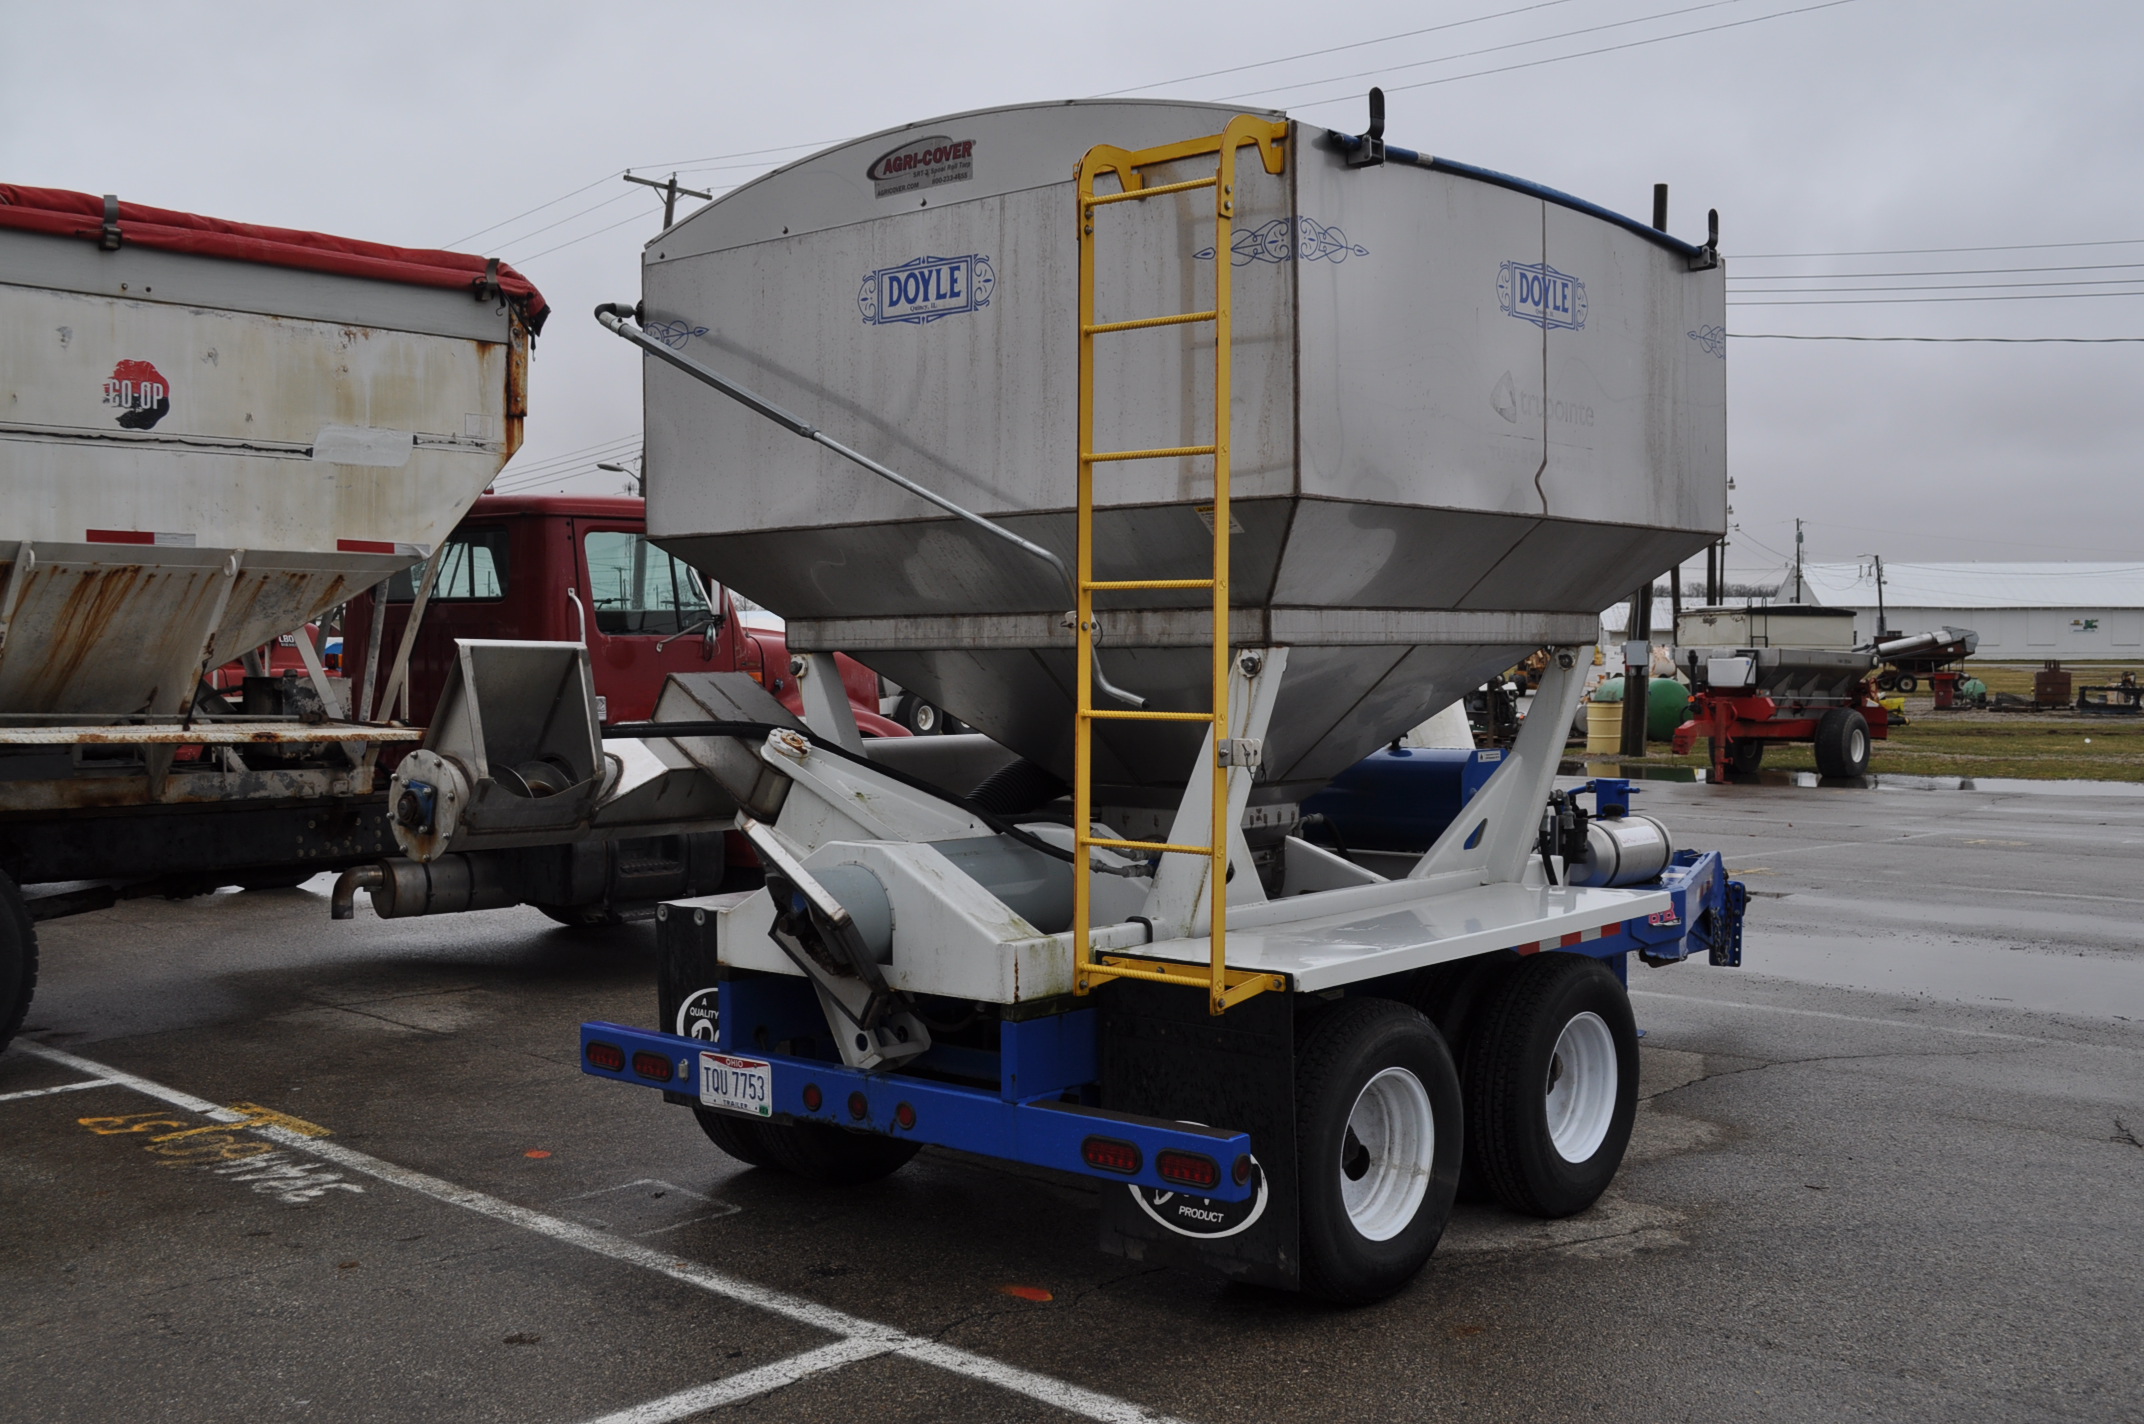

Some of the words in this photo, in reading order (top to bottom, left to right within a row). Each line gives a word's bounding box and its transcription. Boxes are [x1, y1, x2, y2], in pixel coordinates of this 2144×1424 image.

[883, 141, 973, 175] AGRI-COVER
[888, 265, 961, 308] DOYLE
[1519, 271, 1569, 313] DOYLE
[701, 997, 707, 1006] A
[690, 1006, 719, 1019] QUALITY
[725, 1058, 743, 1068] OHIO
[704, 1067, 728, 1095] TQU
[732, 1071, 765, 1102] 7753
[723, 1099, 748, 1109] TRAILER
[1178, 1205, 1224, 1223] PRODUCT
